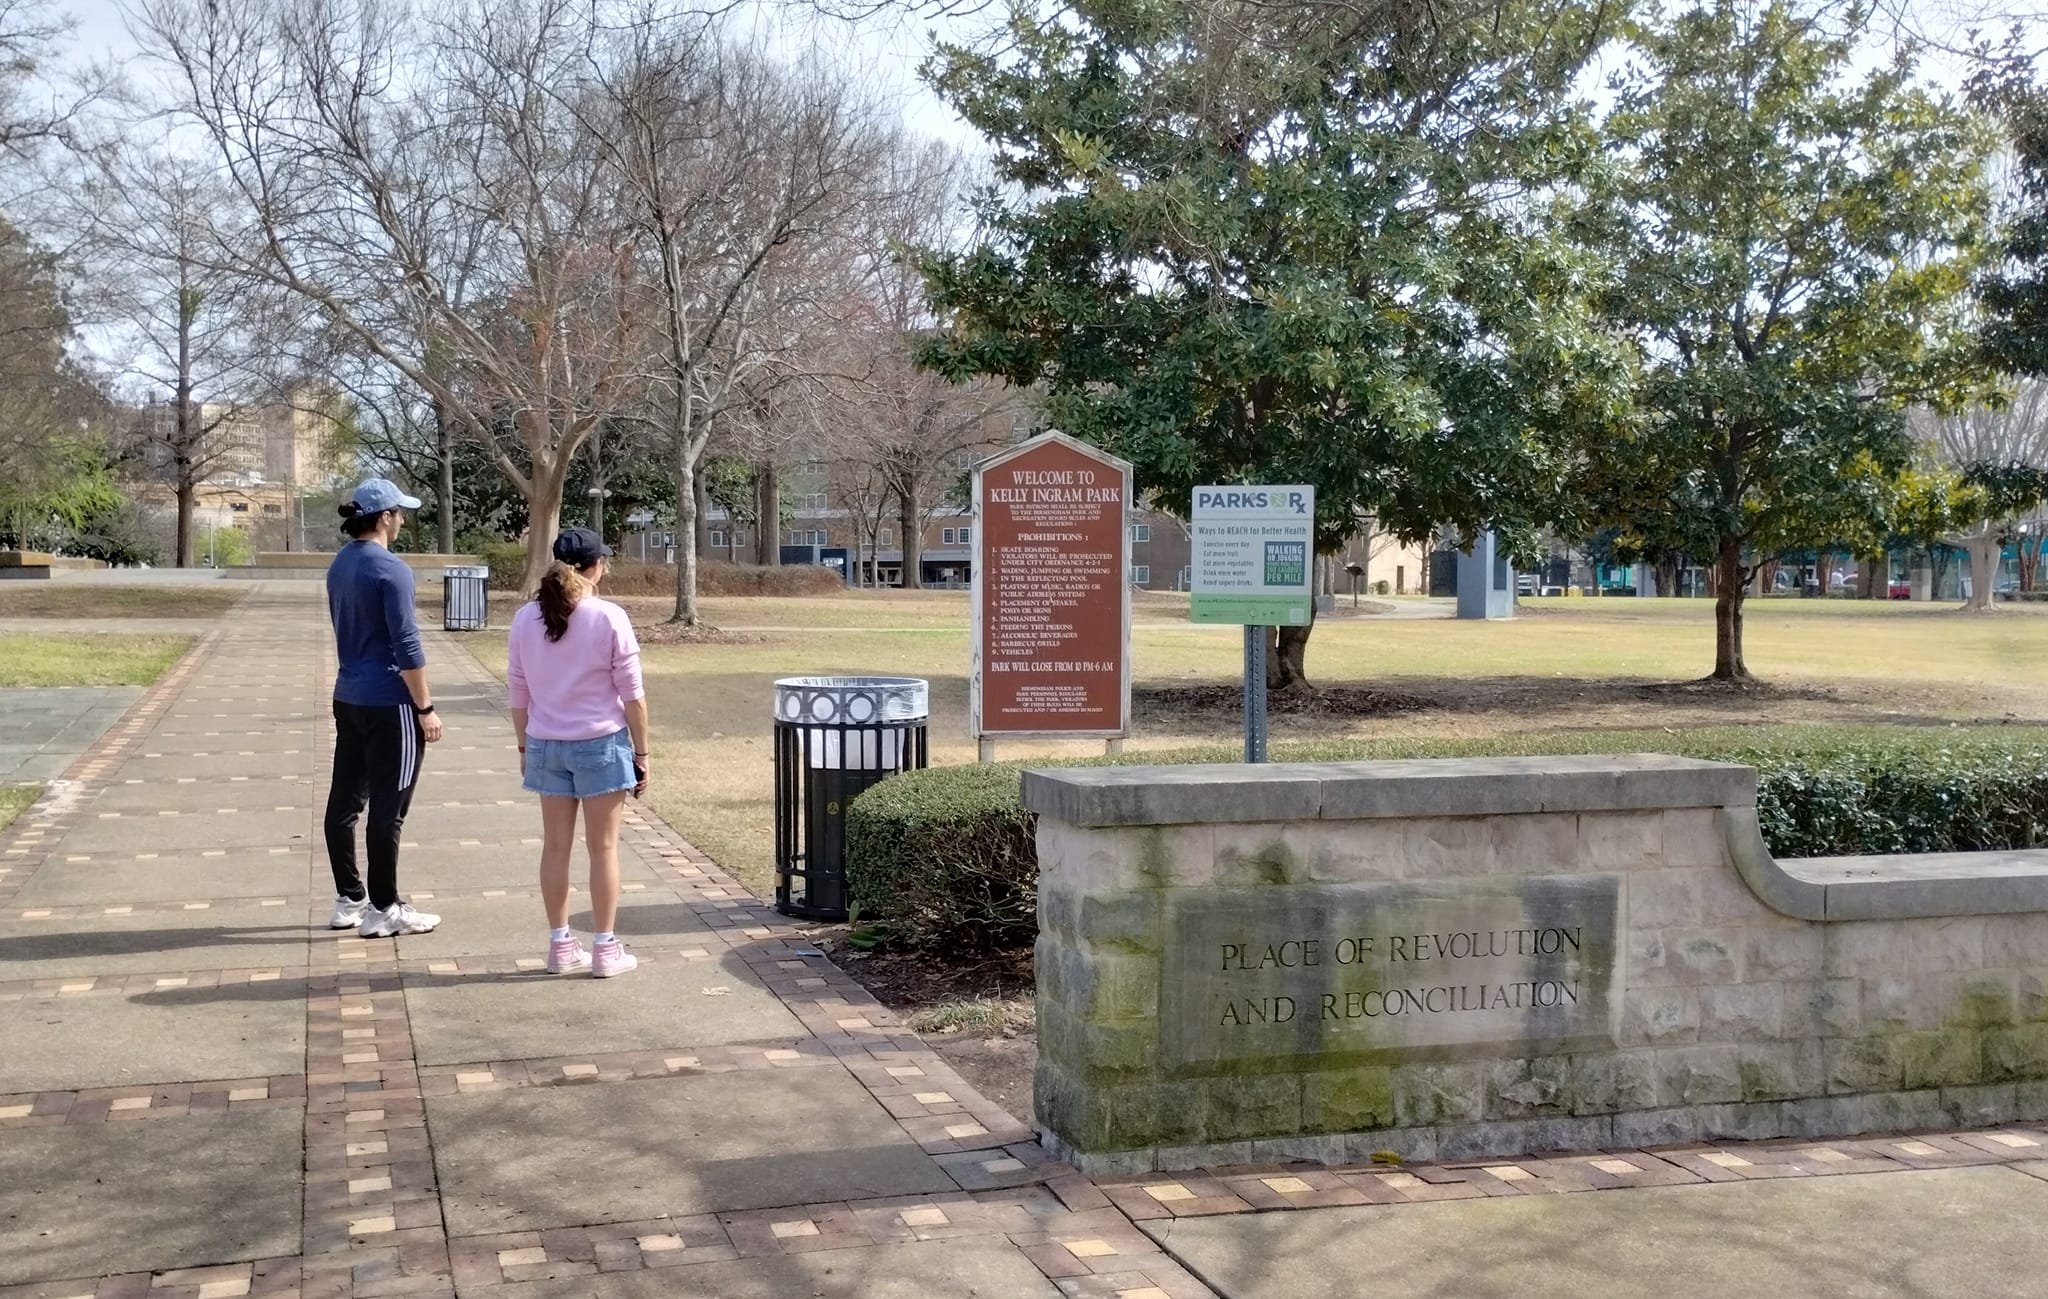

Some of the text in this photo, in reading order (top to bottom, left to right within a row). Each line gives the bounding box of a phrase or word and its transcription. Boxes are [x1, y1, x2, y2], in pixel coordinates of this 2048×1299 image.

[1012, 470, 1094, 485] WELCOME TO
[991, 488, 1120, 502] KELLY INGRAM PARK
[1199, 492, 1268, 508] PARKS
[1199, 527, 1216, 536] Ways
[1227, 527, 1248, 535] REACH
[1250, 527, 1260, 535] for
[1262, 527, 1282, 535] Better
[1284, 527, 1306, 535] Health
[1267, 545, 1303, 554] WALKING
[1267, 573, 1302, 582] PER MILE
[992, 662, 1010, 672] PARK
[1012, 662, 1030, 672] WILL
[1032, 662, 1052, 672] CLOSE
[1054, 662, 1073, 672] FROM
[1101, 662, 1113, 672] AM
[1221, 926, 1582, 970] PLACE OF REVOLUTION
[1220, 980, 1580, 1026] AND RECONCILIATION
